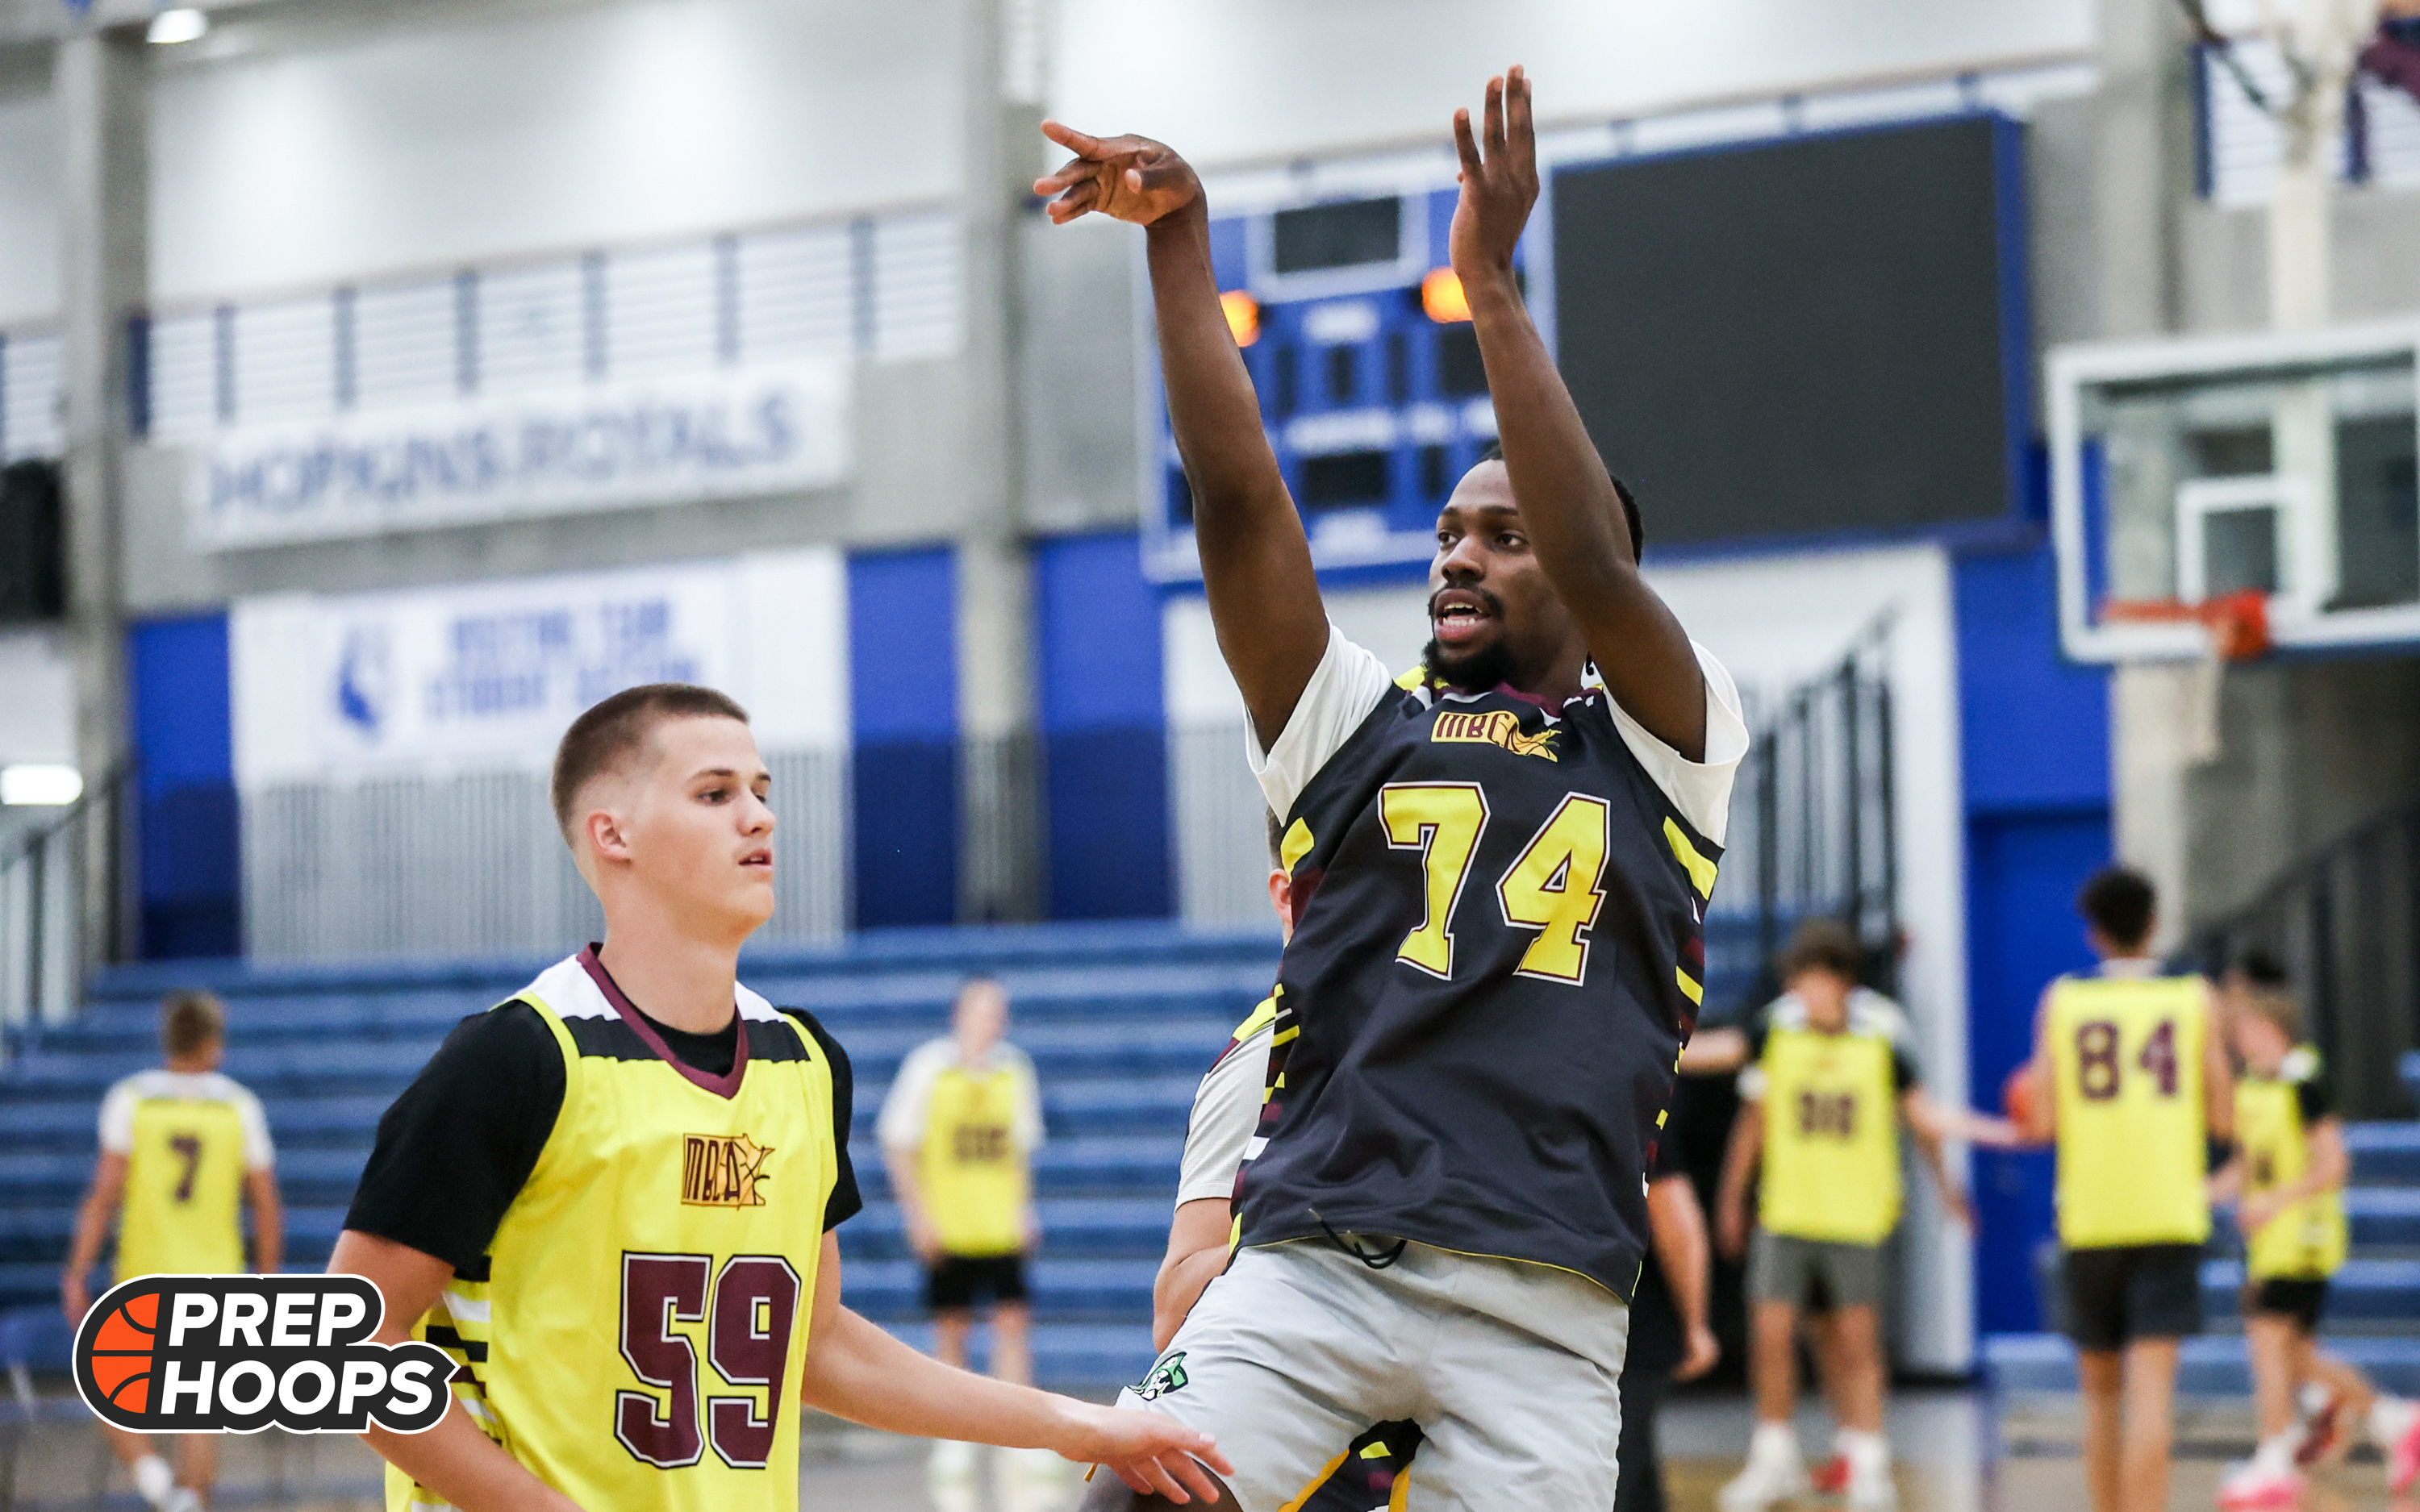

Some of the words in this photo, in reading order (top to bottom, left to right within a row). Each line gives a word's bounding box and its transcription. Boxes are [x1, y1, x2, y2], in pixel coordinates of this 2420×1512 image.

[1378, 780, 1611, 987] 74
[2074, 1018, 2180, 1103] 84
[169, 1132, 202, 1204] 7
[614, 1250, 801, 1469] 59
